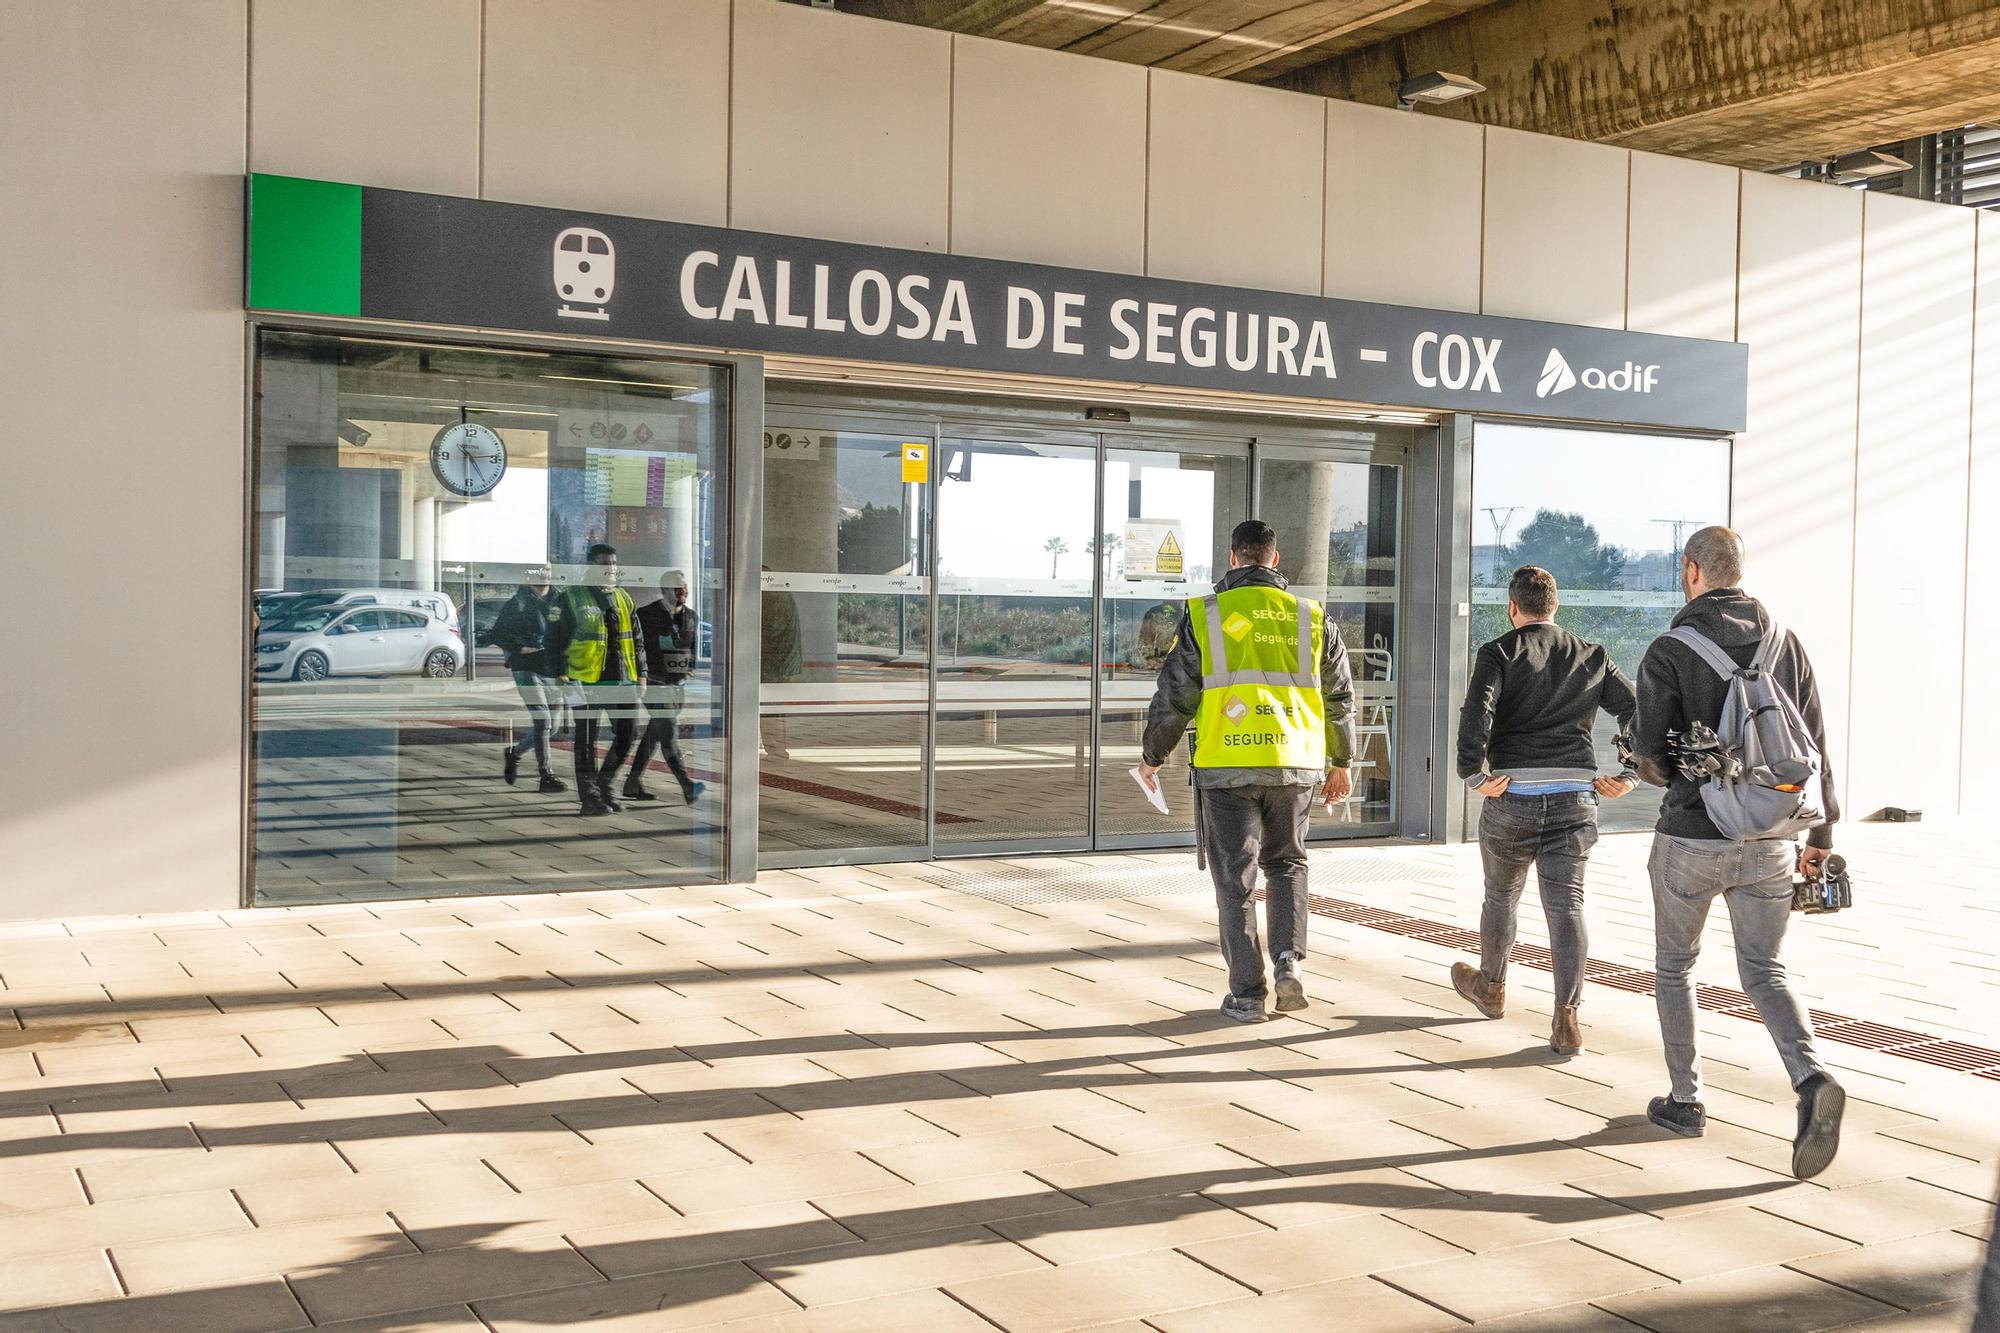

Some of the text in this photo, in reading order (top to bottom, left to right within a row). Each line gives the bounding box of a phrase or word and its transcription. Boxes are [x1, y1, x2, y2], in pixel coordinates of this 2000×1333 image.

[680, 250, 978, 345] CALLOSA
[1006, 285, 1086, 356] DE
[1109, 298, 1338, 379] SEGURA
[1411, 331, 1505, 394] COX
[1581, 361, 1661, 395] adif
[465, 428, 477, 438] 12
[441, 451, 450, 460] 9
[490, 455, 498, 464] 3
[465, 478, 474, 487] 6
[1251, 609, 1298, 622] SECOE
[1254, 632, 1299, 646] Segurida
[667, 657, 693, 668] adi
[1224, 733, 1289, 747] SEGURID
